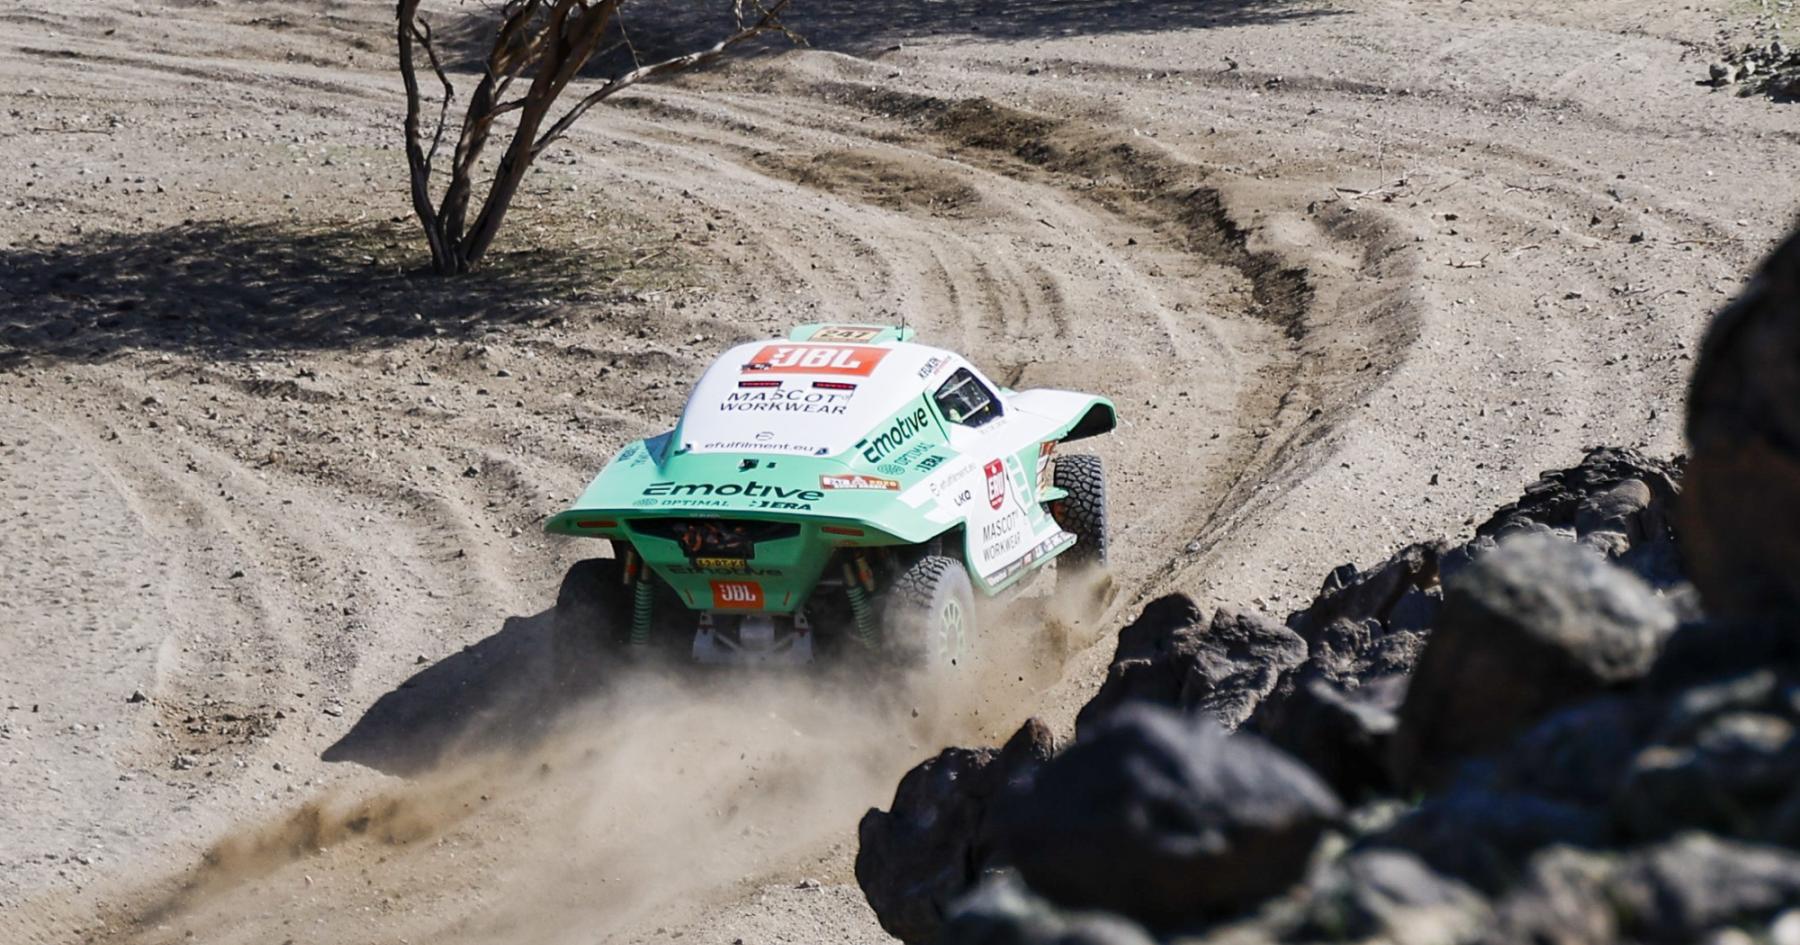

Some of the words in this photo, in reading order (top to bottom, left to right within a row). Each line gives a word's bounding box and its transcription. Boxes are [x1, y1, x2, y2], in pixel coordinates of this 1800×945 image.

[769, 346, 861, 369] JBL
[727, 389, 837, 403] MASCOT
[720, 401, 847, 415] WORKWEAR
[855, 407, 928, 463] Emotive
[704, 442, 815, 453] efulfilment.eu
[642, 481, 825, 501] Emotive
[953, 489, 972, 507] LKQ
[661, 499, 730, 507] OPTIMAL
[983, 511, 1017, 543] MASCOT
[982, 531, 1021, 562] WORKWEAR
[718, 583, 756, 602] JBL
